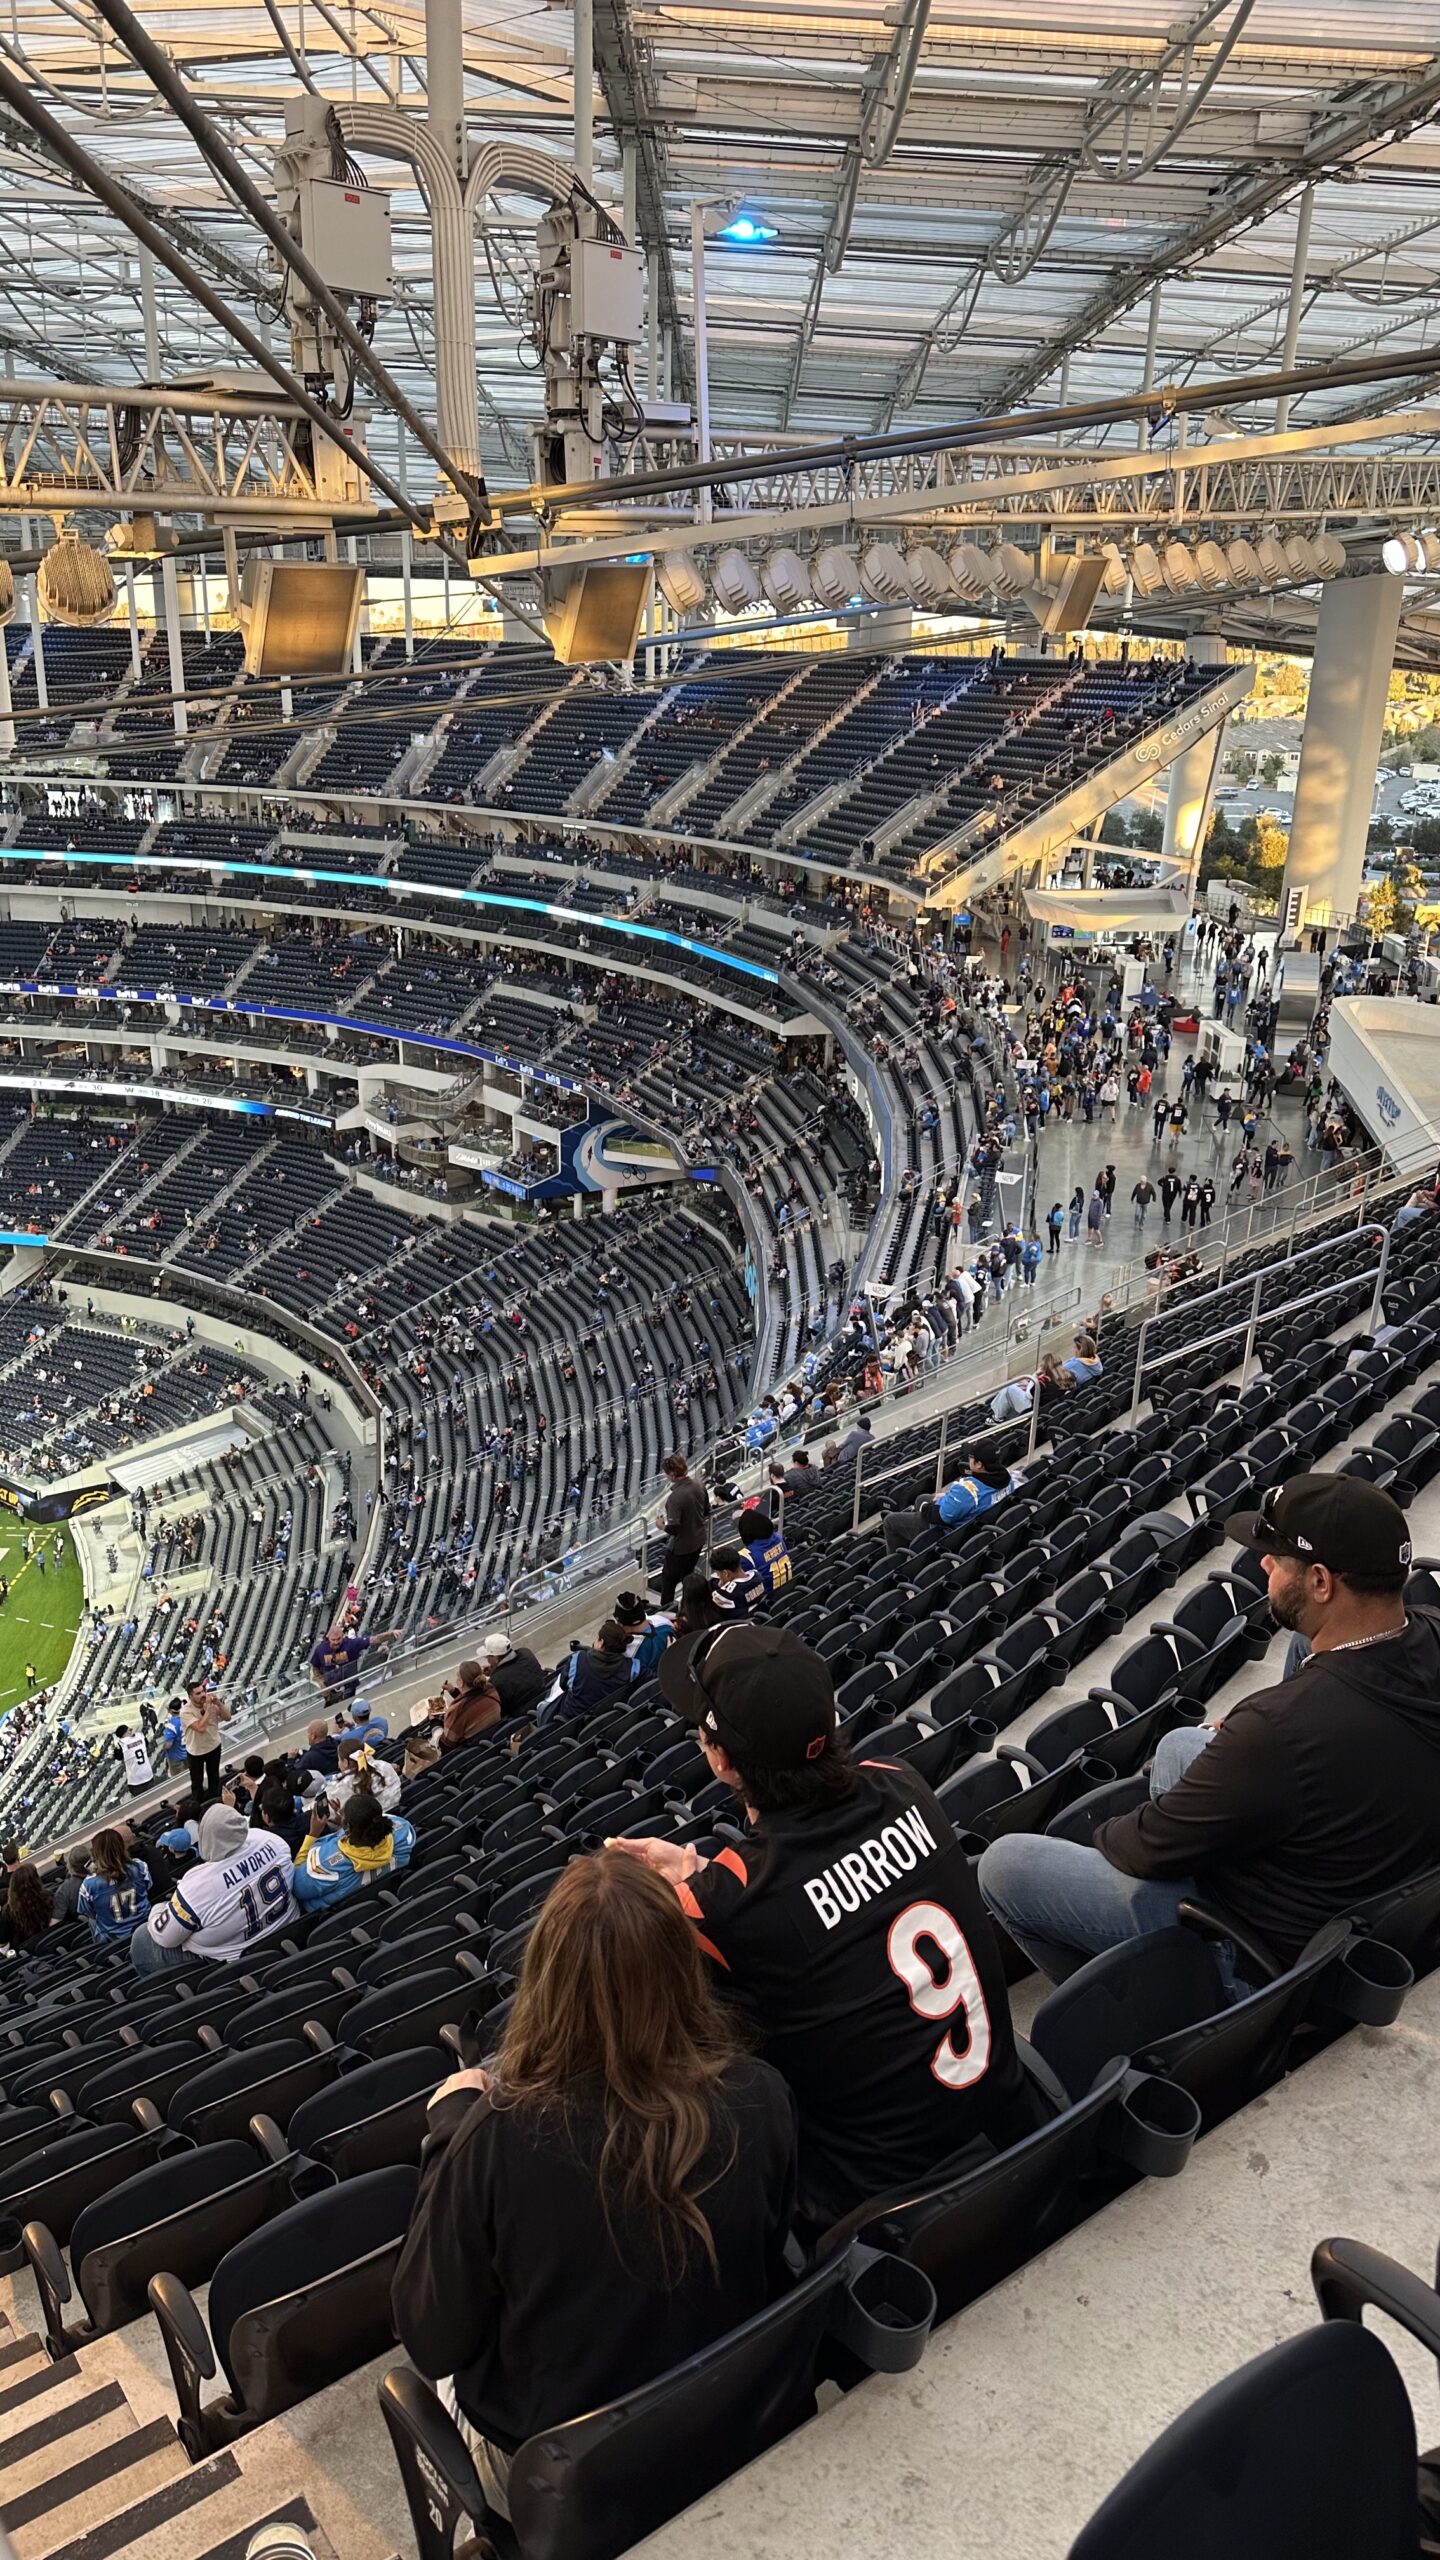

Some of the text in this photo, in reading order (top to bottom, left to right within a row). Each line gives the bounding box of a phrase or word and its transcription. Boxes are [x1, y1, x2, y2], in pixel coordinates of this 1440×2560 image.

[1162, 692, 1229, 745] Cedars Sinai
[151, 1089, 160, 1097] 18
[872, 1285, 887, 1295] 425
[769, 1554, 793, 1590] 10
[134, 1748, 145, 1765] 9
[222, 1843, 278, 1890] ALWORTH
[803, 1805, 938, 1930] BURROW
[110, 1888, 138, 1923] 17
[239, 1864, 291, 1941] 19
[886, 1900, 992, 2090] 9
[428, 2498, 443, 2533] 20
